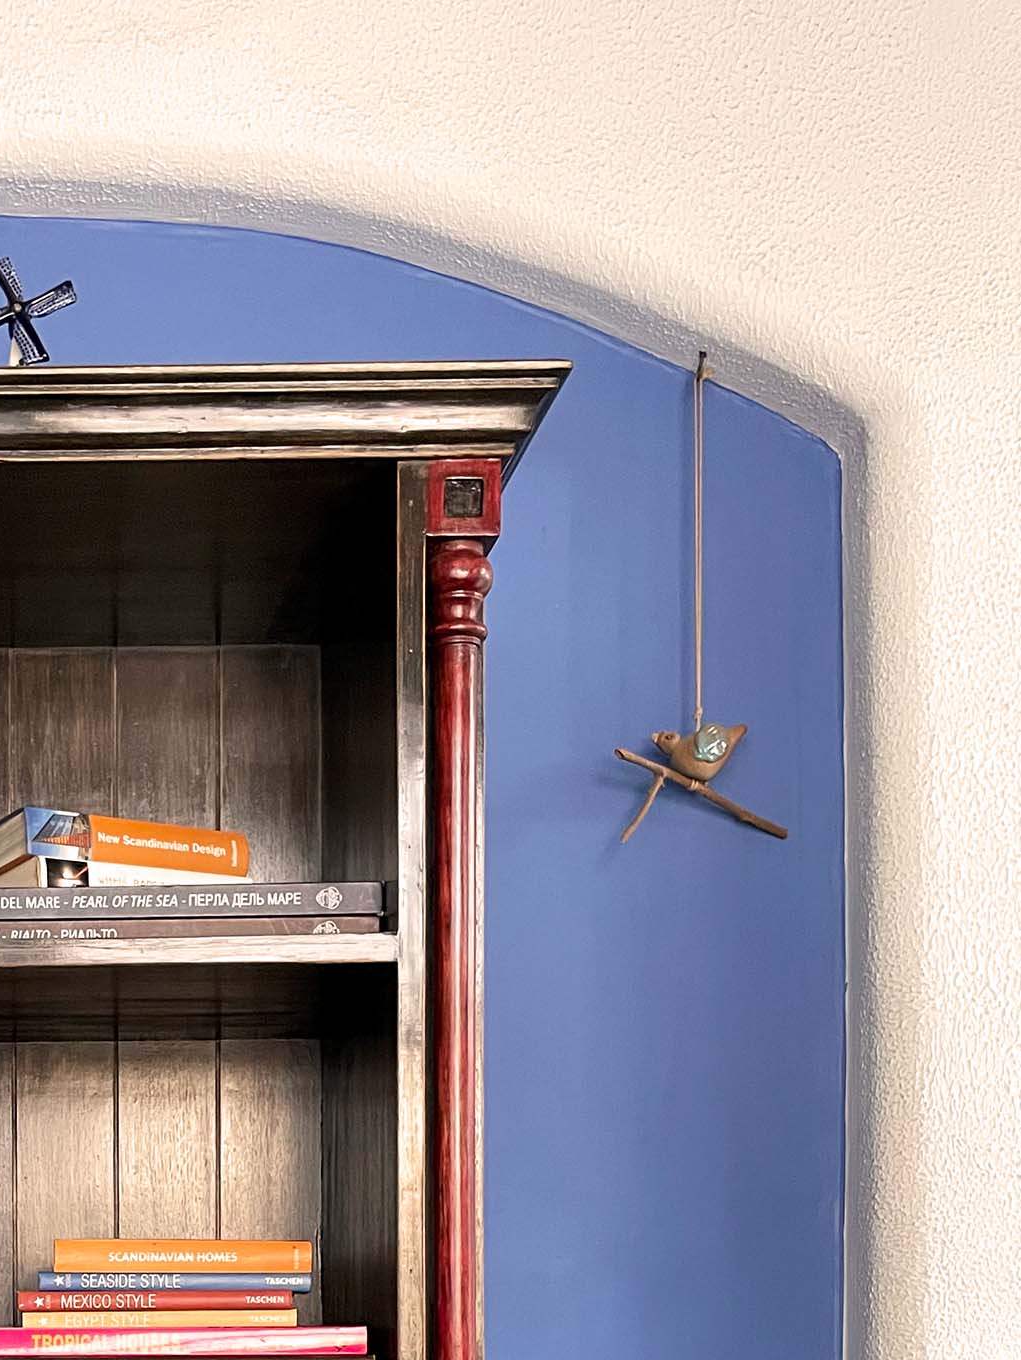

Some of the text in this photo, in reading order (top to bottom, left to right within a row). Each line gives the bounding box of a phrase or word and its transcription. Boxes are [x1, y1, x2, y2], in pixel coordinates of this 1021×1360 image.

[97, 831, 120, 844] New
[123, 834, 190, 852] Scandinavian
[192, 843, 226, 857] Design
[0, 896, 22, 909] DEL
[25, 896, 60, 909] MARE
[72, 895, 109, 909] PEARL
[111, 895, 129, 908] OF
[130, 895, 153, 908] THE
[155, 894, 178, 907] SEA
[188, 894, 230, 907] ПЕРЛА
[232, 893, 265, 908] ДЕЛЬ
[267, 892, 302, 906] МАРЕ
[108, 1252, 238, 1262] SCANDINAVIAN HOMES
[80, 1274, 136, 1288] SEASIDE
[140, 1274, 181, 1288] STYLE
[265, 1277, 304, 1285] TASCHEN
[61, 1294, 111, 1308] MEXICO
[115, 1294, 156, 1308] STYLE
[245, 1296, 284, 1304] TASCHEN
[65, 1313, 112, 1327] EGYPT
[115, 1313, 152, 1327] STYLE
[32, 1334, 109, 1349] TROPICAL
